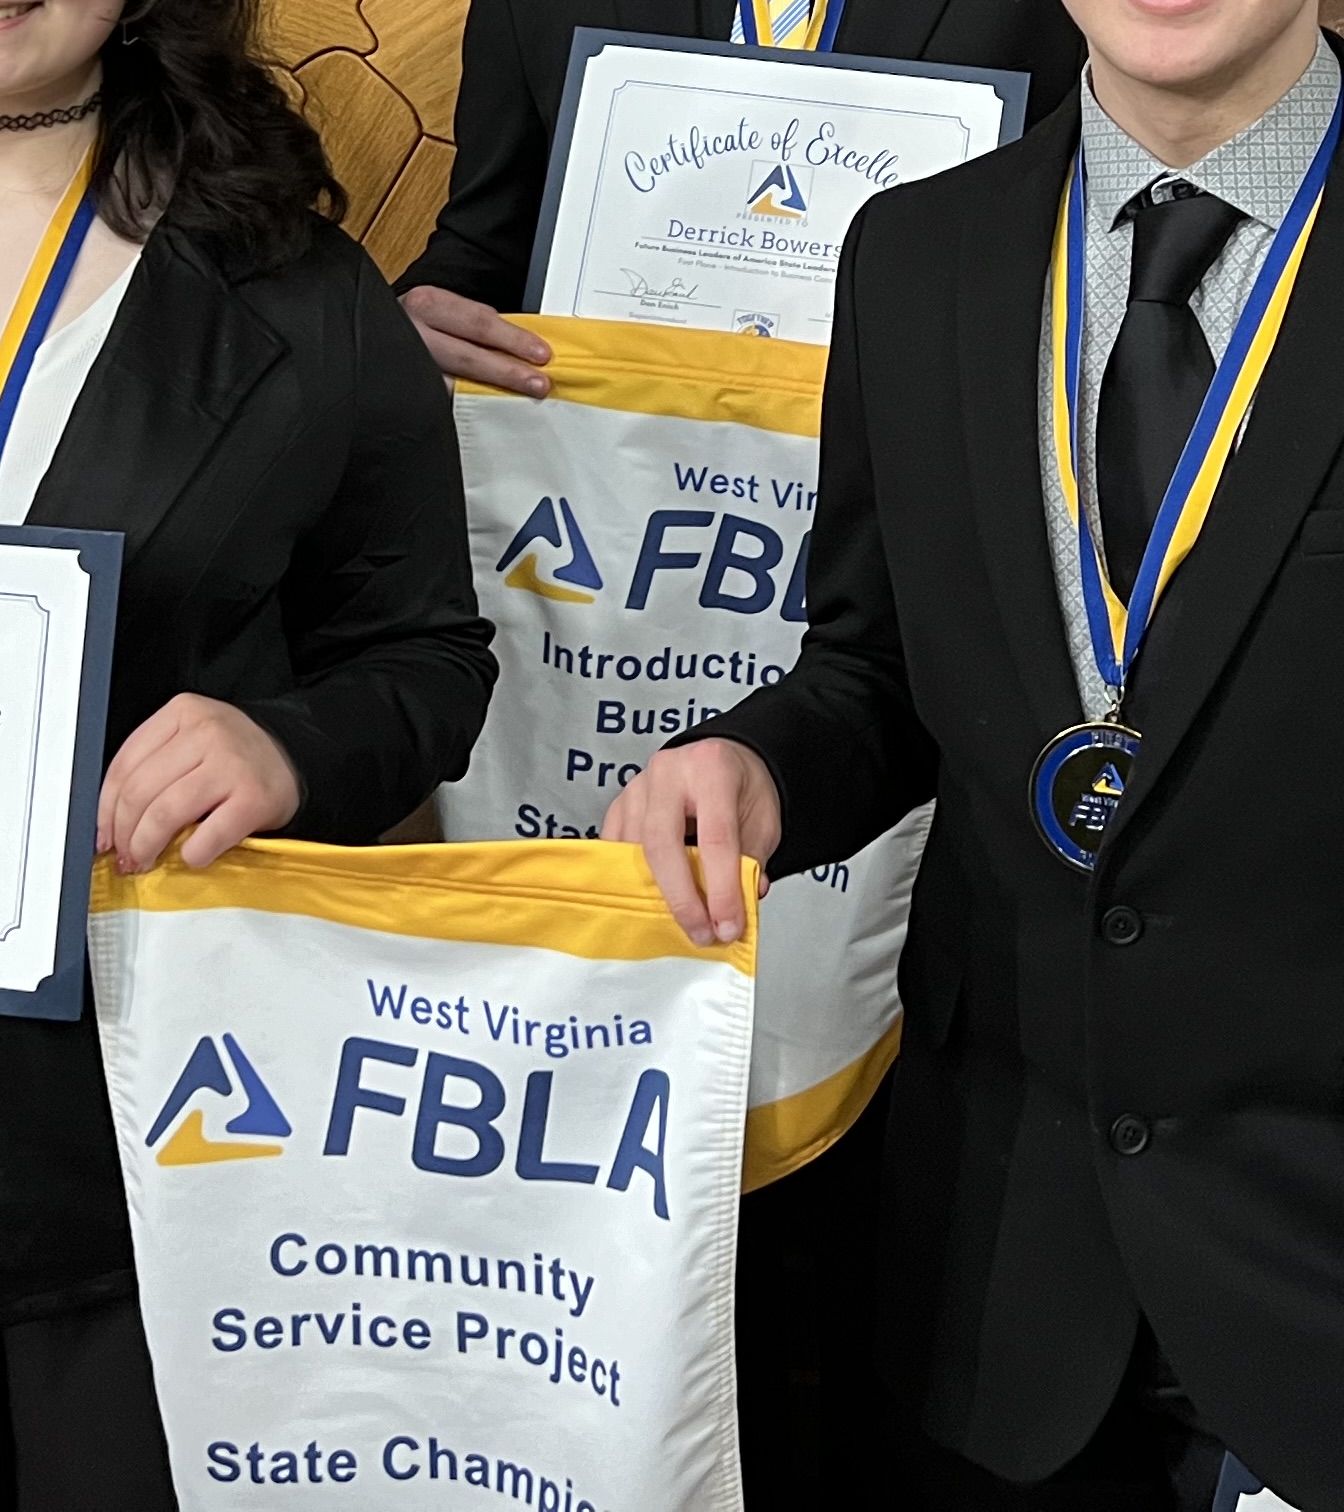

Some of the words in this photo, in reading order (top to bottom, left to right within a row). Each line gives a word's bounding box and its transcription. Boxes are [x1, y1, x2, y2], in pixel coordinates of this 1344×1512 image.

[624, 117, 762, 192] Certificate
[770, 118, 798, 161] of
[806, 122, 899, 189] Excelle
[667, 219, 755, 248] Derrick
[736, 213, 791, 225] PRESENTED
[796, 219, 808, 227] TO
[635, 241, 660, 251] Future
[662, 245, 696, 256] Business
[743, 255, 777, 266] America
[803, 262, 836, 272] Leaders
[674, 463, 760, 503] West
[625, 510, 812, 622] FBL
[543, 632, 786, 687] Introductio
[367, 979, 470, 1034] West
[483, 1001, 653, 1057] Virginia
[322, 1036, 670, 1221] FBLA
[270, 1232, 594, 1317] Community
[211, 1303, 432, 1352] Service
[455, 1311, 621, 1407] Project
[206, 1440, 357, 1484] State
